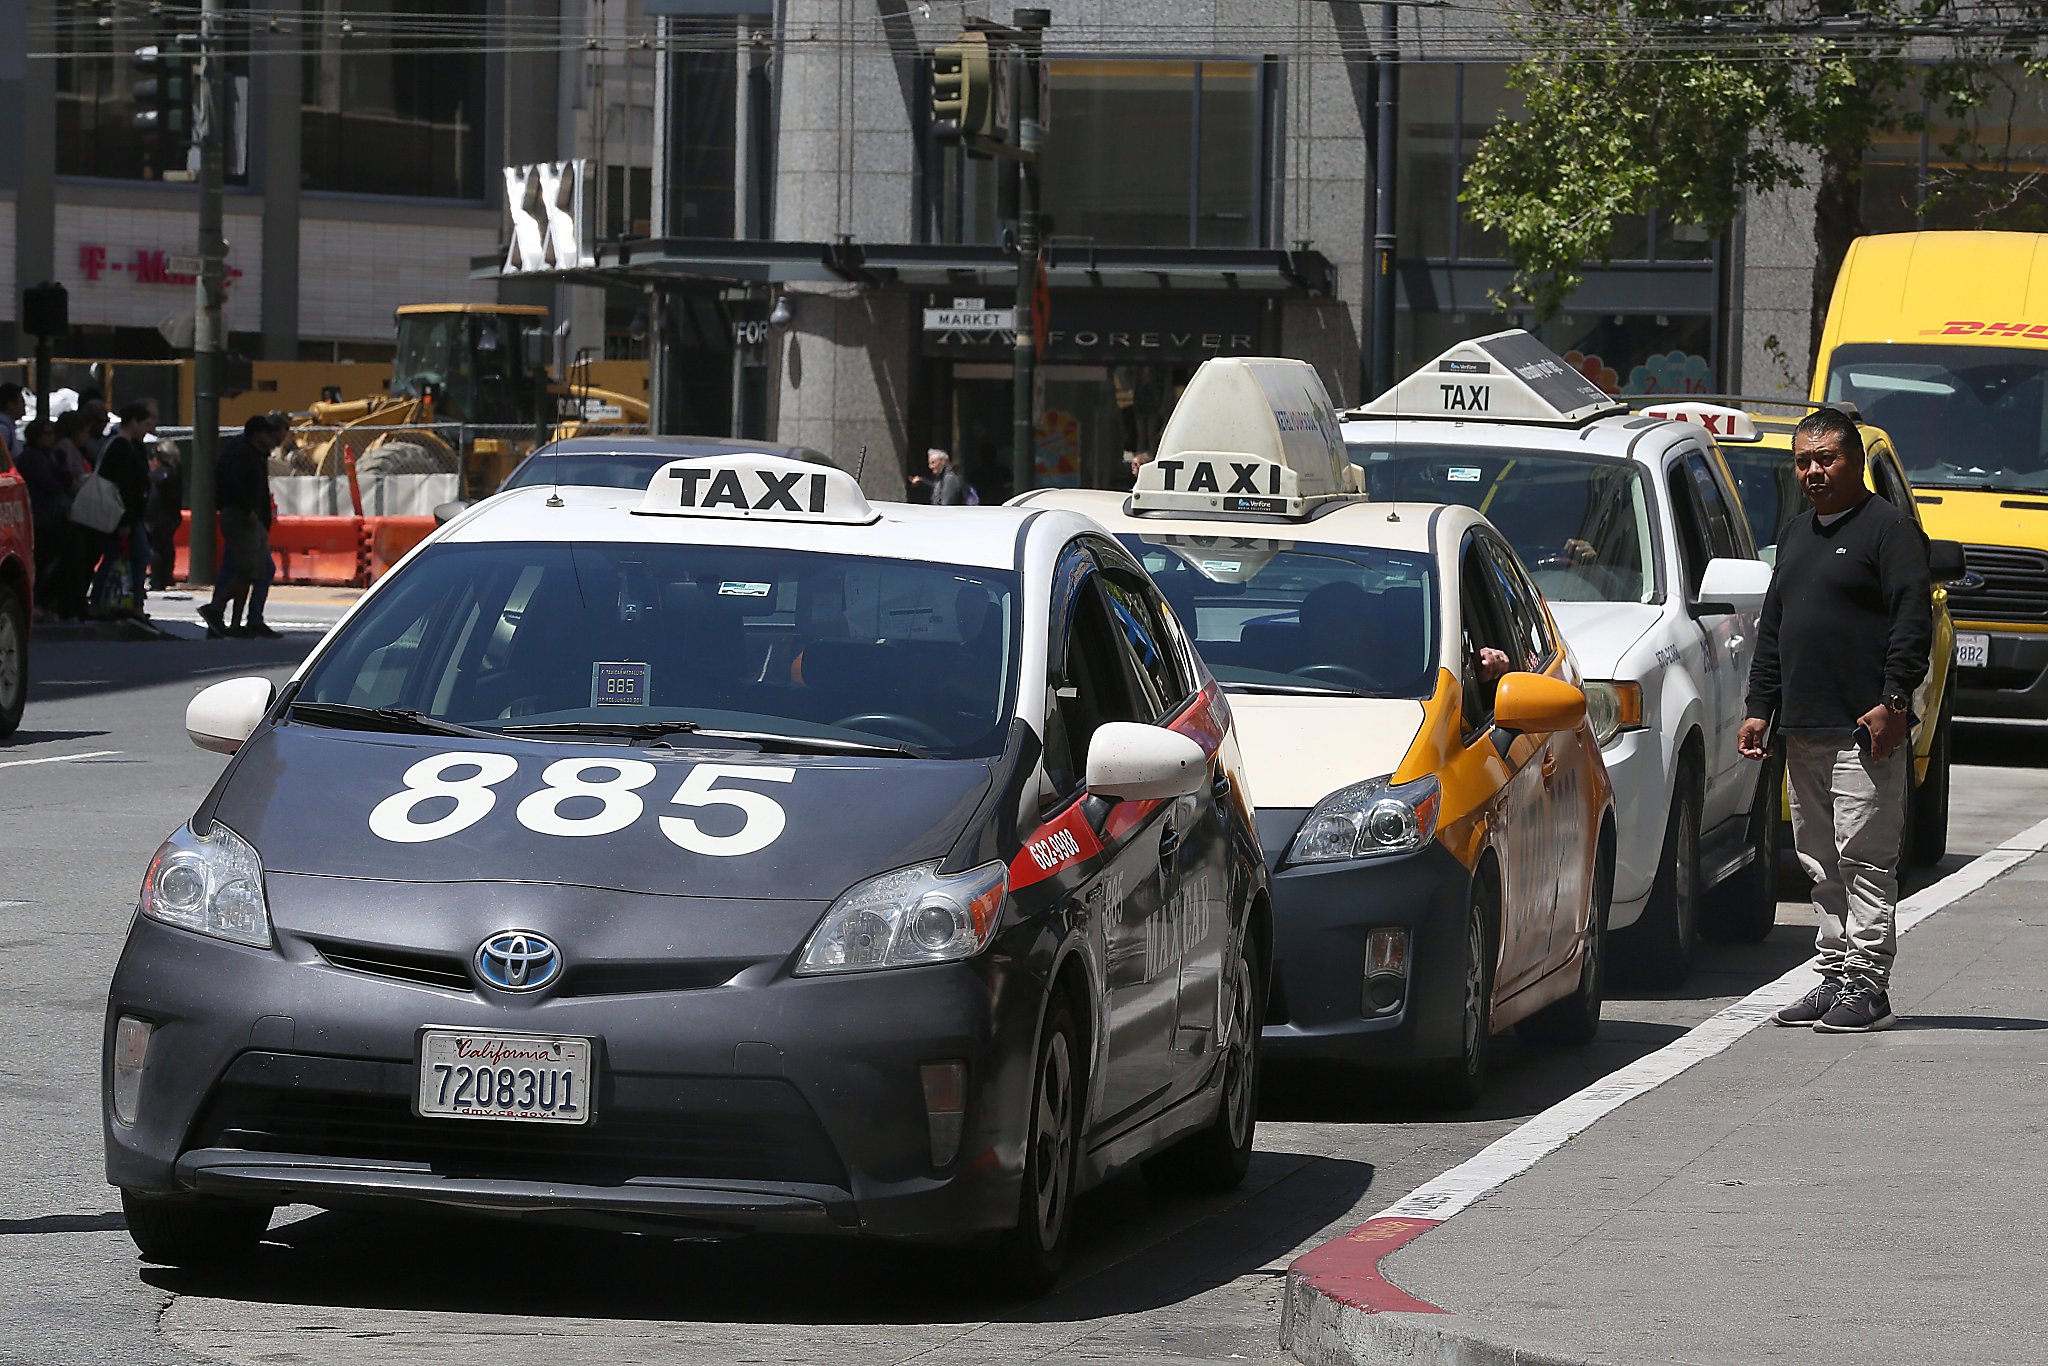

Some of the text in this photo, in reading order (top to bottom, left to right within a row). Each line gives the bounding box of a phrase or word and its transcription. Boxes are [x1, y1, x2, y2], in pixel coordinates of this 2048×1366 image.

[939, 313, 1001, 326] MARKET
[1048, 331, 1251, 348] FOREVER
[1440, 384, 1490, 411] TAXI
[669, 467, 827, 513] TAXI
[1157, 460, 1281, 495] TAXI
[607, 678, 634, 693] 885
[367, 750, 799, 858] 885
[458, 1039, 560, 1065] California
[434, 1064, 577, 1111] 72083U1
[462, 1107, 548, 1118] dmv.ca.gov
